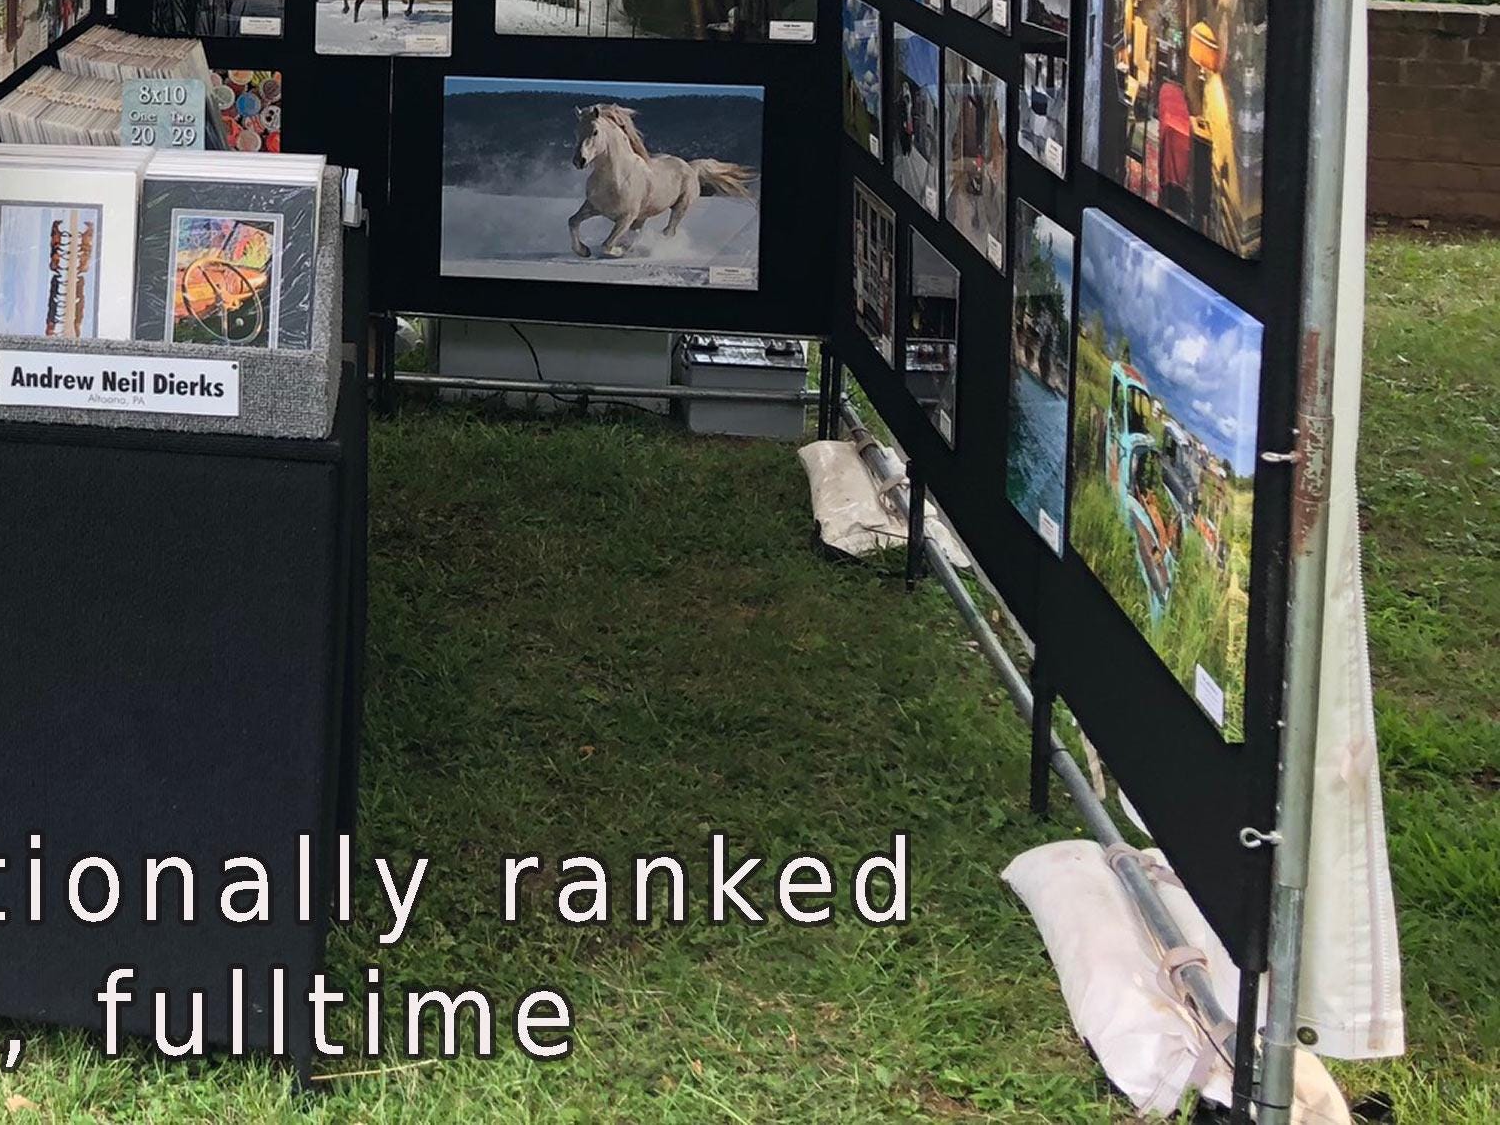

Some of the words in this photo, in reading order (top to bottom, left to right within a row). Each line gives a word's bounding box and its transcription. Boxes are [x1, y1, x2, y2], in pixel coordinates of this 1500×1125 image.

[138, 84, 187, 105] 8x10
[128, 110, 158, 123] One
[131, 126, 156, 146] 20
[172, 127, 197, 146] 29
[10, 366, 94, 391] Andrew
[102, 370, 145, 394] Neil
[153, 373, 225, 398] Dierks
[132, 395, 146, 406] PA
